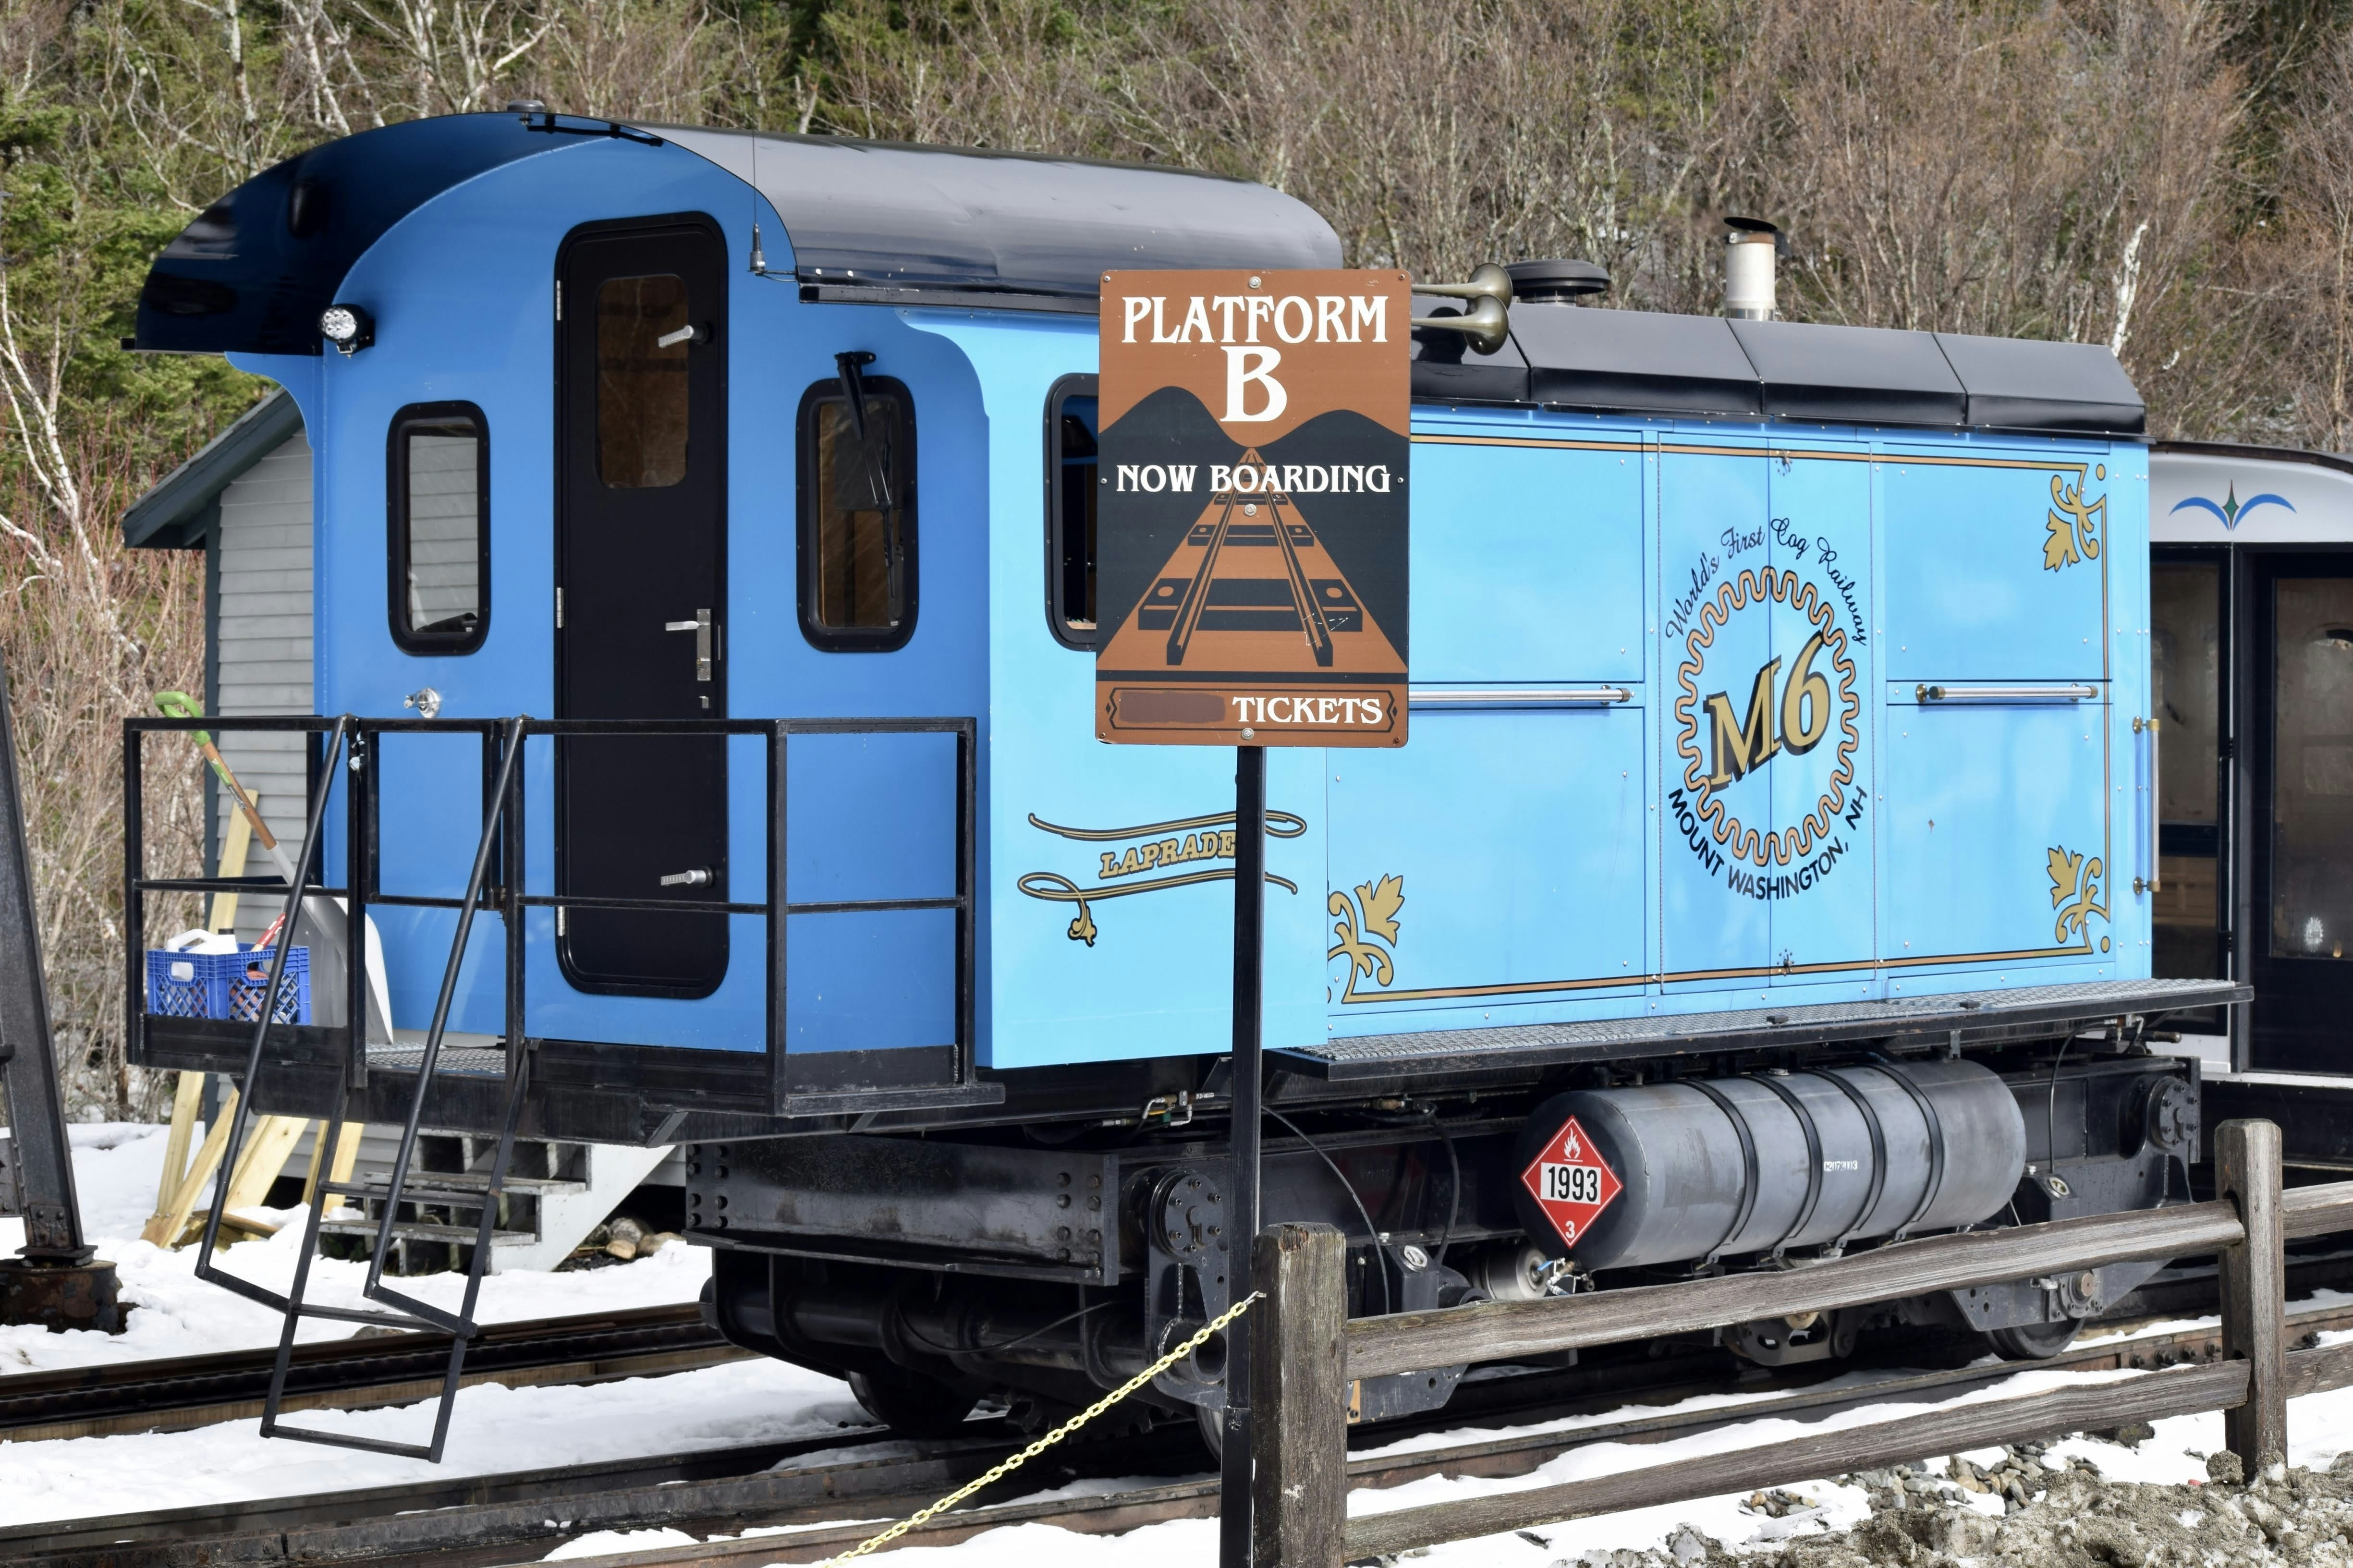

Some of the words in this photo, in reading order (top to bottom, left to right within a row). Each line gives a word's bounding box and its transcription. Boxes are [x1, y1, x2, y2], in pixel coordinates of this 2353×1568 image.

[1122, 295, 1389, 344] PLATFORM
[1219, 345, 1288, 422] B
[1116, 465, 1198, 492] NOW
[1209, 464, 1391, 493] BOARDING
[1665, 552, 1719, 639] World's
[1720, 525, 1766, 559] First
[1770, 517, 1810, 560] Cog
[1817, 536, 1867, 646] Railway
[1232, 696, 1383, 724] TICKETS
[1703, 629, 1831, 793] M6
[1098, 829, 1237, 879] LAPRADE
[1668, 788, 1725, 876] MOUNT
[1728, 836, 1849, 900] WASHINGTON,
[1845, 785, 1868, 830] NH
[1548, 1166, 1598, 1202] 1993
[1565, 1220, 1576, 1239] 3
